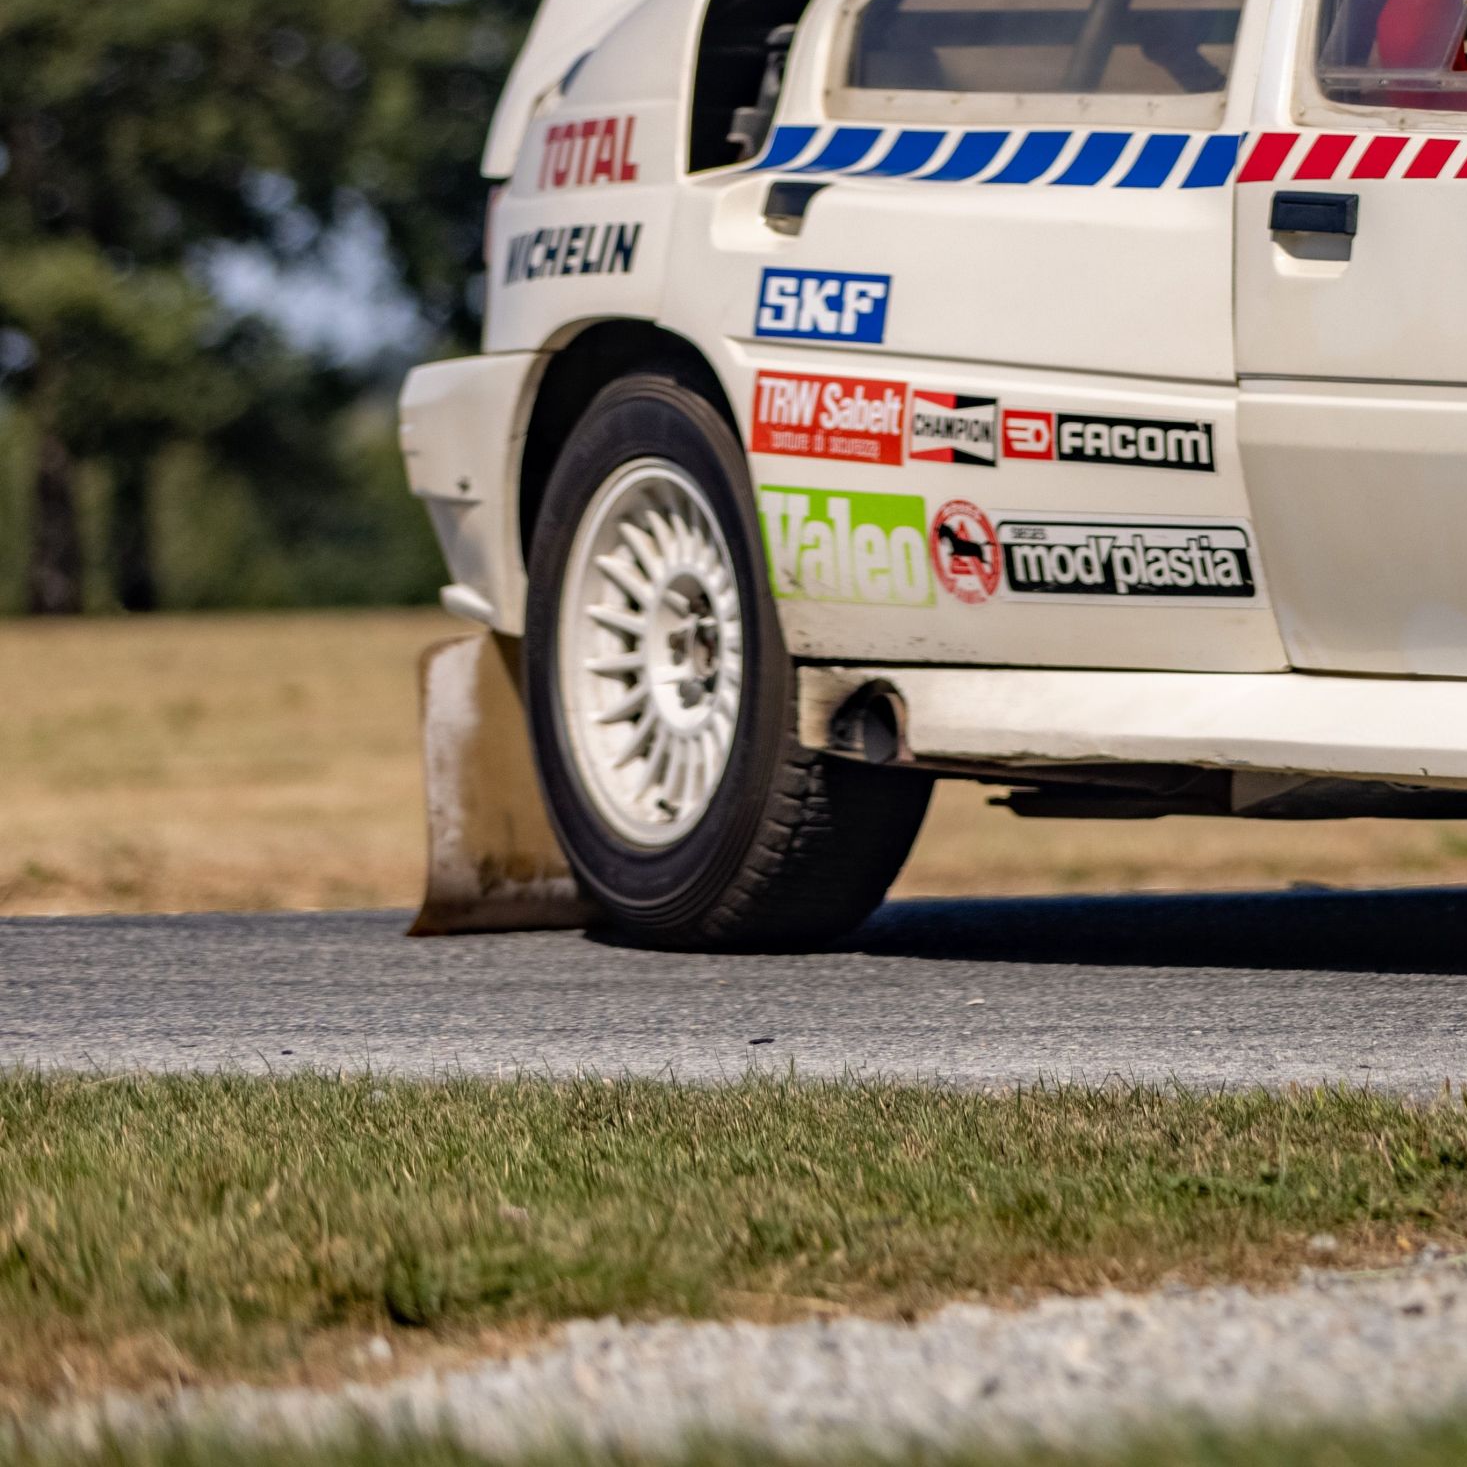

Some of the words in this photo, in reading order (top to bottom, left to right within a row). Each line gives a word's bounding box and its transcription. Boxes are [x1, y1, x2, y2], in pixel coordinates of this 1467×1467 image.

[540, 116, 640, 188] TOTAL
[504, 222, 643, 286] MICHELIN
[759, 276, 886, 335] SKF
[758, 376, 820, 426] TRW
[820, 382, 902, 436] Sabelt
[913, 413, 992, 442] CHAMPION
[1059, 421, 1212, 465] FACOM
[760, 490, 930, 604] Valeo
